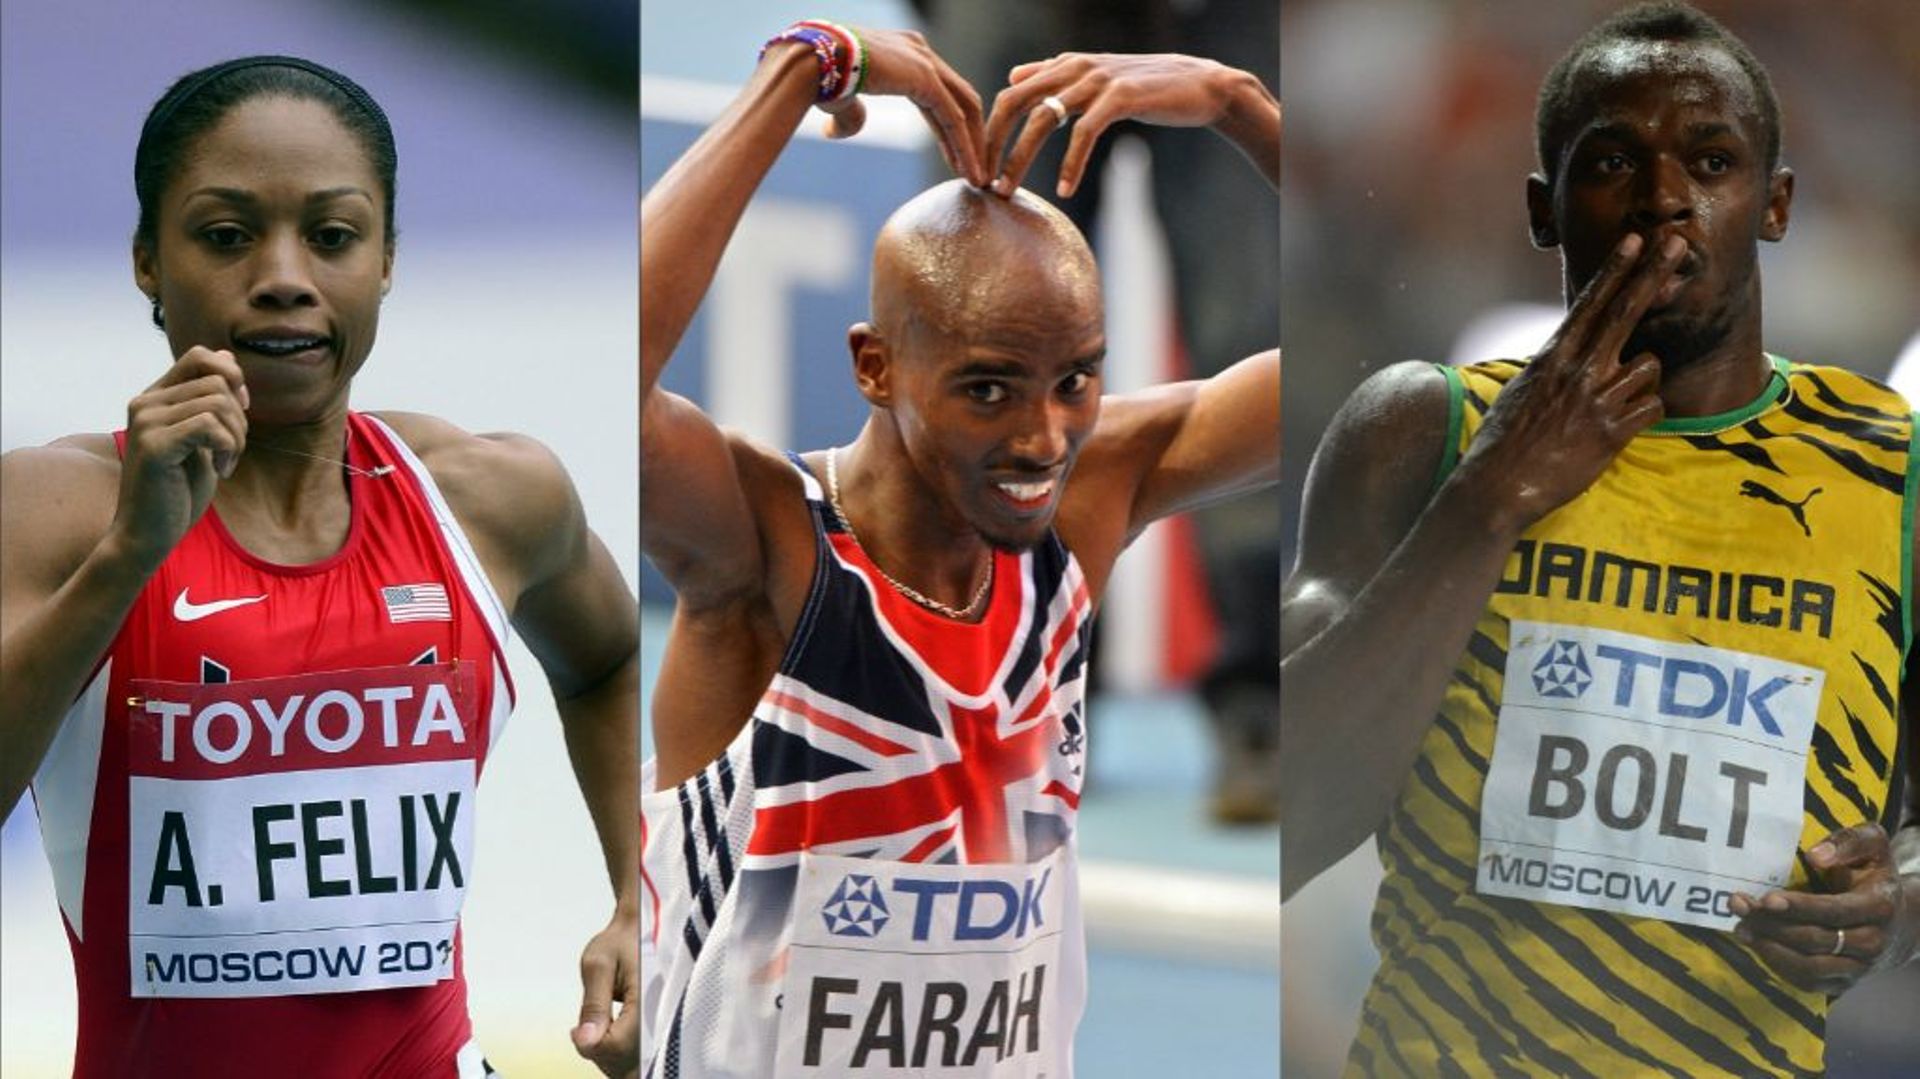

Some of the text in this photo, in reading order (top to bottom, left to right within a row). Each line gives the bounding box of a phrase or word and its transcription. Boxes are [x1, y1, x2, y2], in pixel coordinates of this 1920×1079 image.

[1495, 539, 1837, 640] JAMAICA
[145, 684, 466, 764] TOYOTA
[1596, 644, 1794, 738] TDK
[1527, 734, 1768, 849] BOLT
[148, 791, 465, 907] A. FELIX
[1488, 854, 1735, 918] MOSCOW 20
[892, 868, 1051, 941] TDK
[145, 945, 366, 983] MOSCOW
[803, 964, 1046, 1068] FARAH
